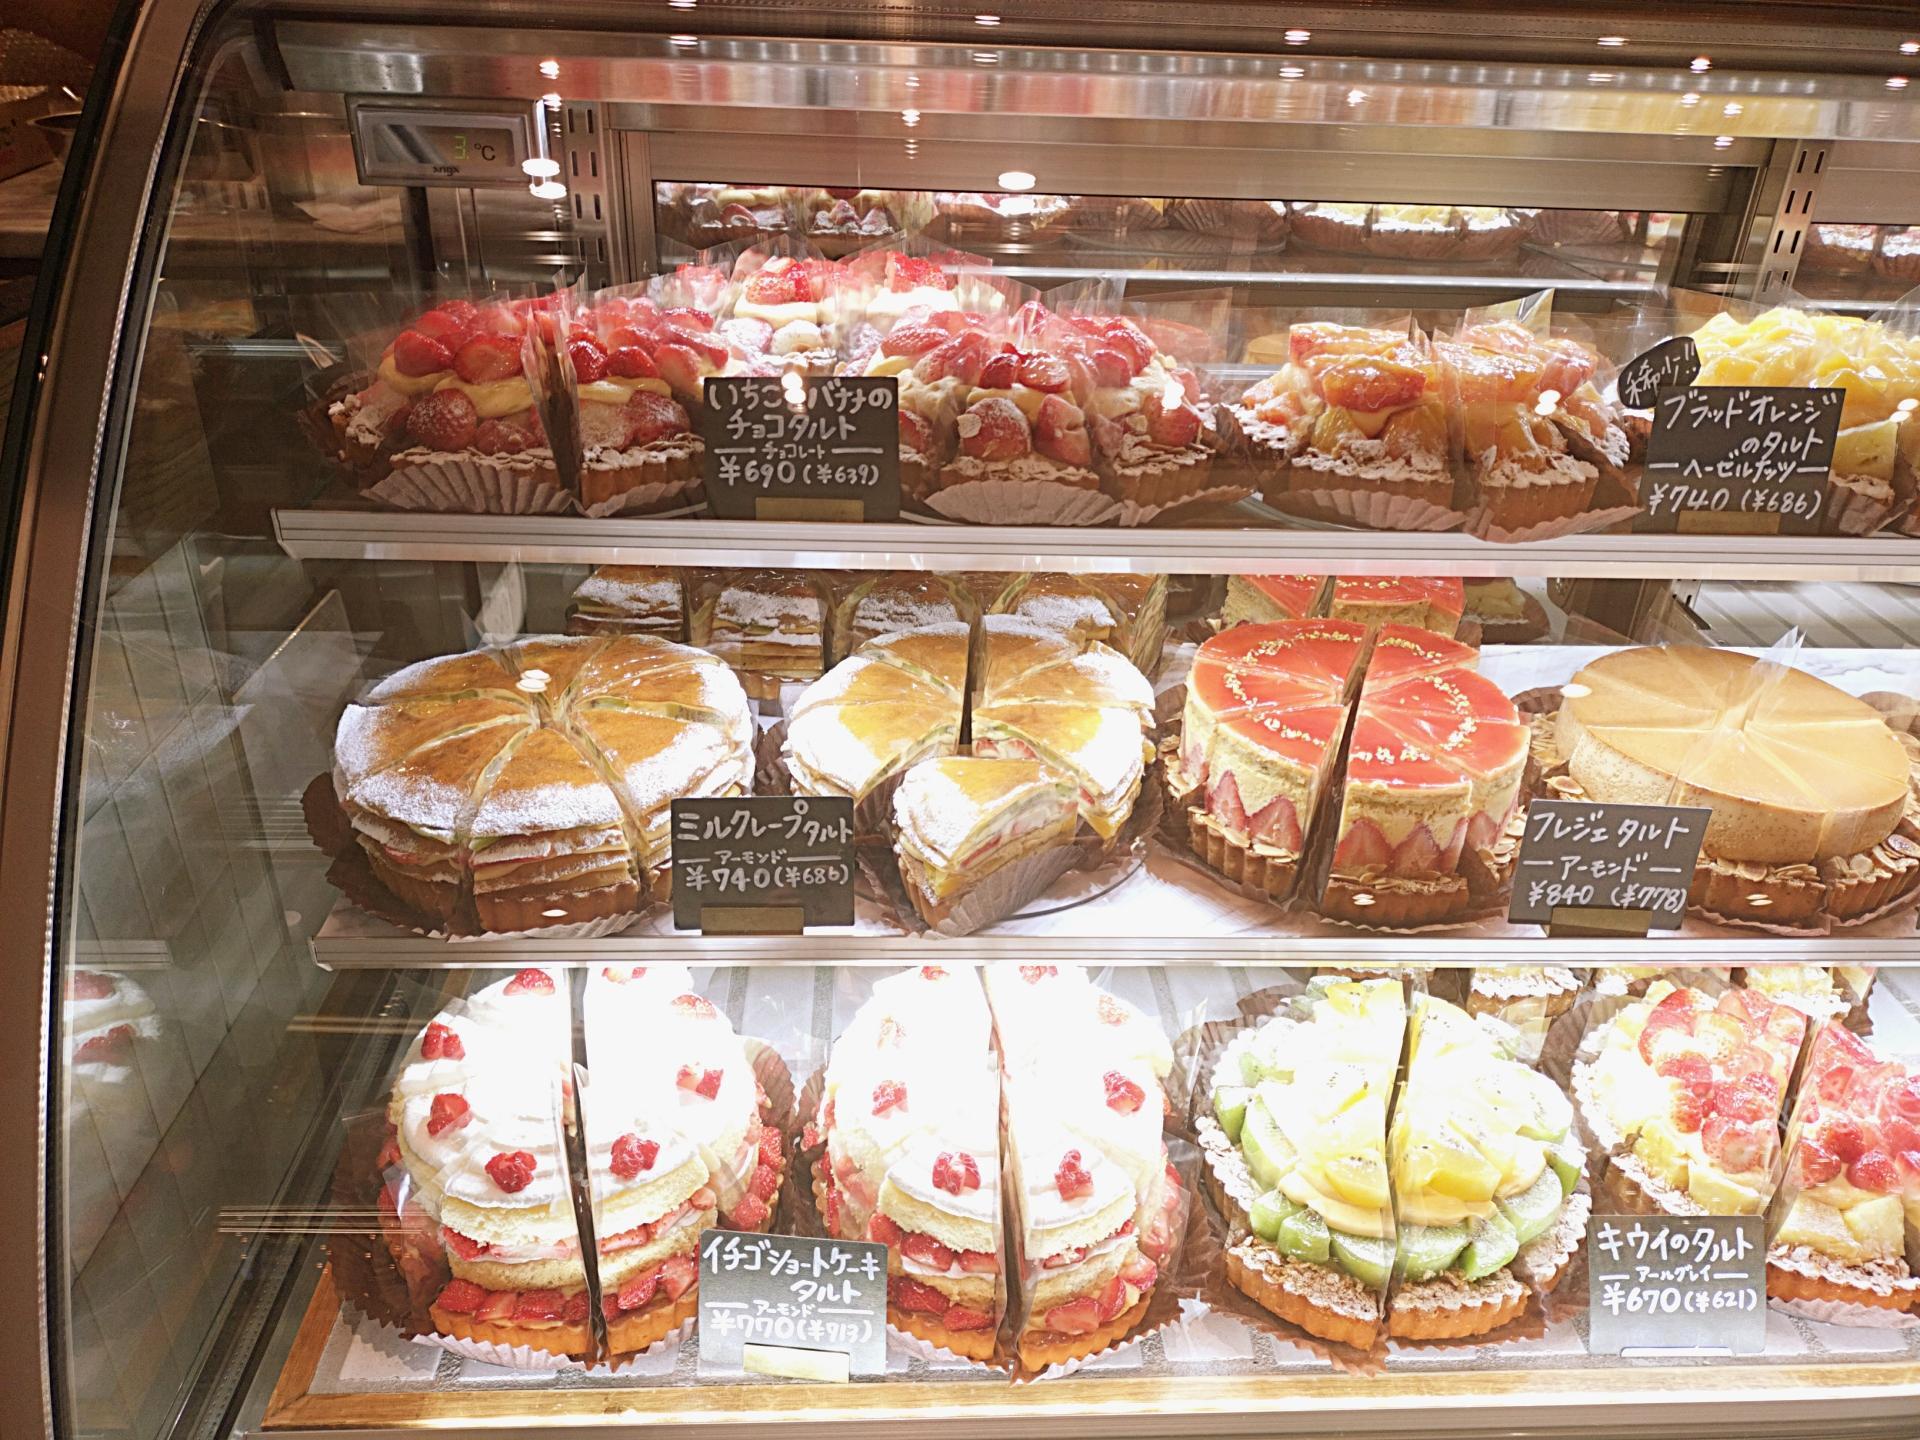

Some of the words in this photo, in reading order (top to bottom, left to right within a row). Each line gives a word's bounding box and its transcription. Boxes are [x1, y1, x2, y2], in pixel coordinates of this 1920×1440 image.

[709, 378, 893, 414] いちごバナナの
[1664, 388, 1837, 429] ブラッドオレンジ
[726, 408, 857, 441] チョコタルト
[761, 440, 826, 460] チョコレート
[1741, 427, 1823, 460] のタルト
[677, 799, 853, 847] ミルクレープタルト
[714, 848, 787, 865] アーモンド
[1560, 852, 1648, 883] アーモンド
[1528, 880, 1594, 908] ¥840
[702, 1235, 881, 1280] イチゴショートケーキ
[1597, 1222, 1753, 1262] キウイのタルト
[1635, 1264, 1711, 1282] アールグレイ
[790, 1279, 862, 1304] タルト
[752, 1299, 816, 1318] アーモンド
